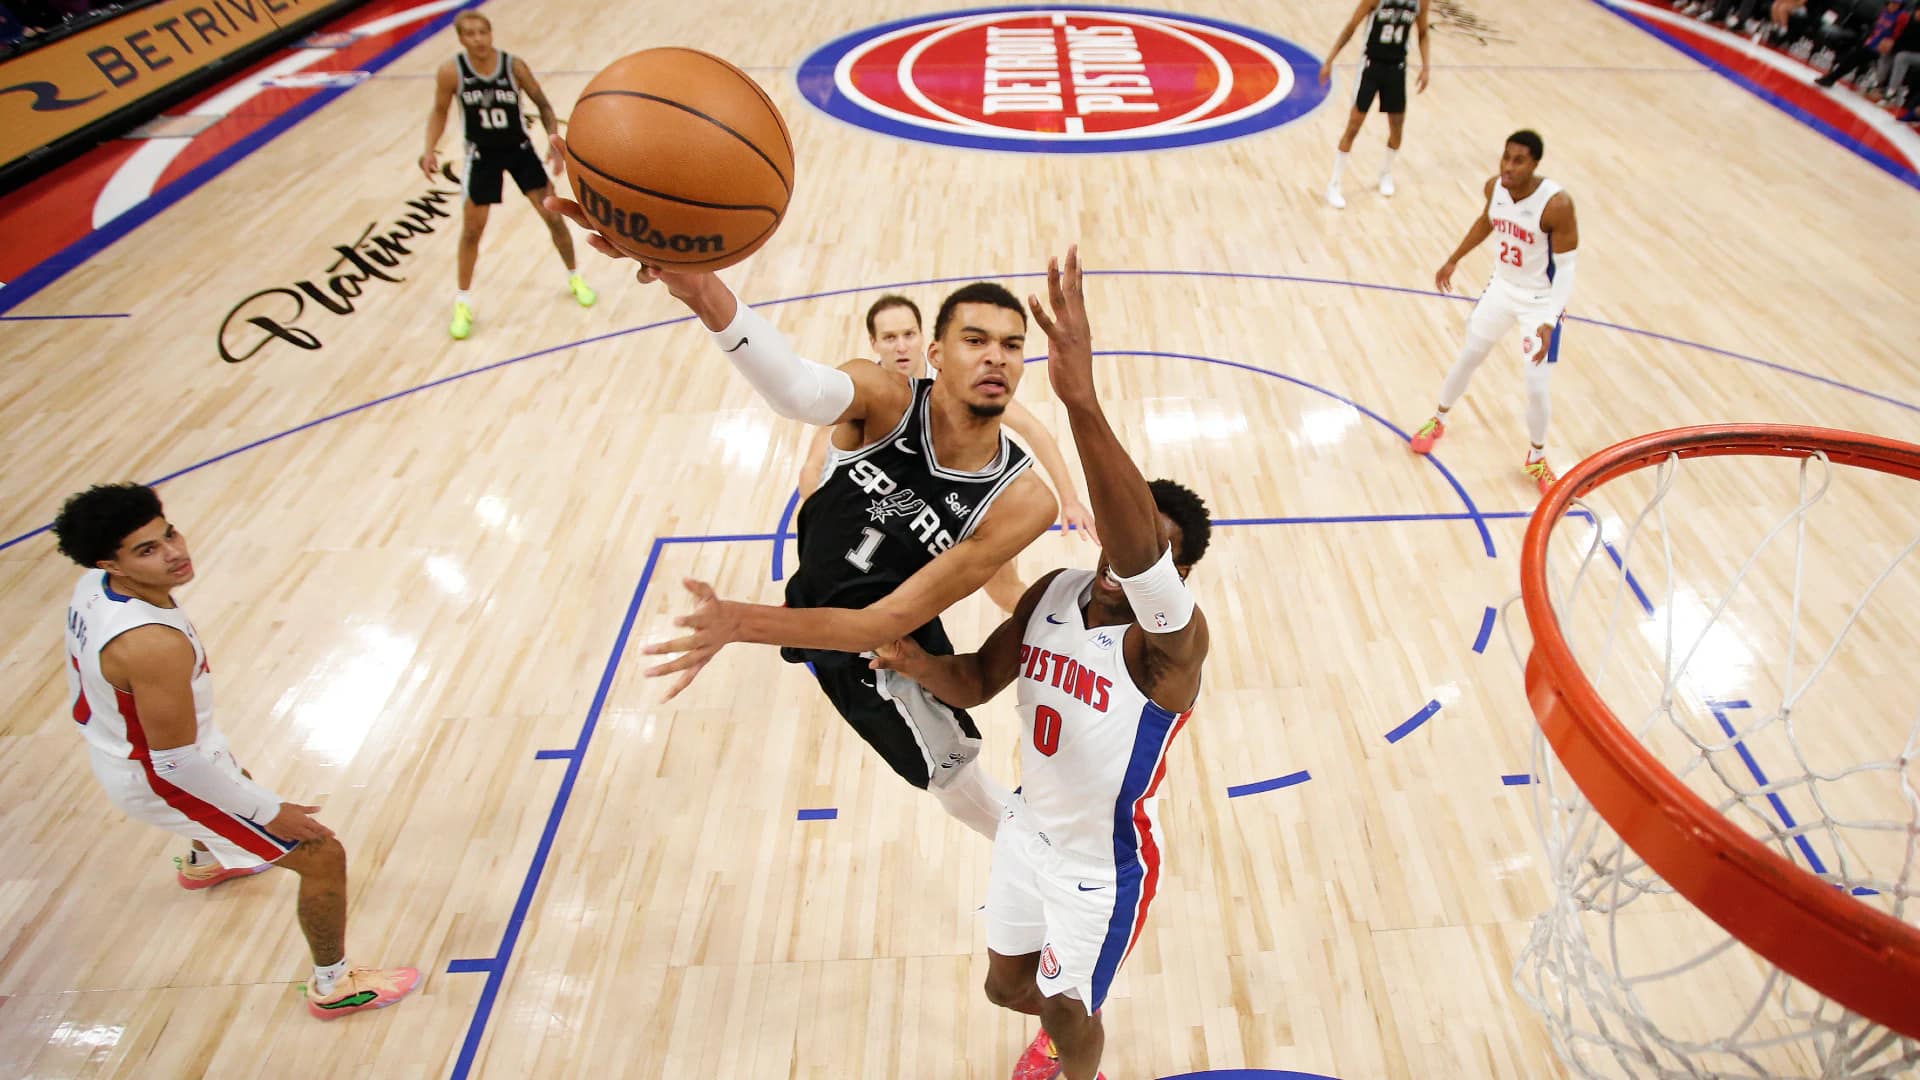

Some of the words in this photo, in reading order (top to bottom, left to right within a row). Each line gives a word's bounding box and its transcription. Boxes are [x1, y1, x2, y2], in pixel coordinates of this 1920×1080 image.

[983, 26, 1064, 115] DETROIT
[1065, 25, 1160, 115] PISTONS
[479, 108, 508, 129] 10
[577, 176, 725, 252] Wilson
[1493, 218, 1534, 245] PISTONS
[217, 189, 461, 363] Platinum
[1500, 241, 1523, 268] 23
[848, 459, 955, 557] SPURS
[844, 526, 886, 574] 1
[1033, 704, 1062, 757] 0
